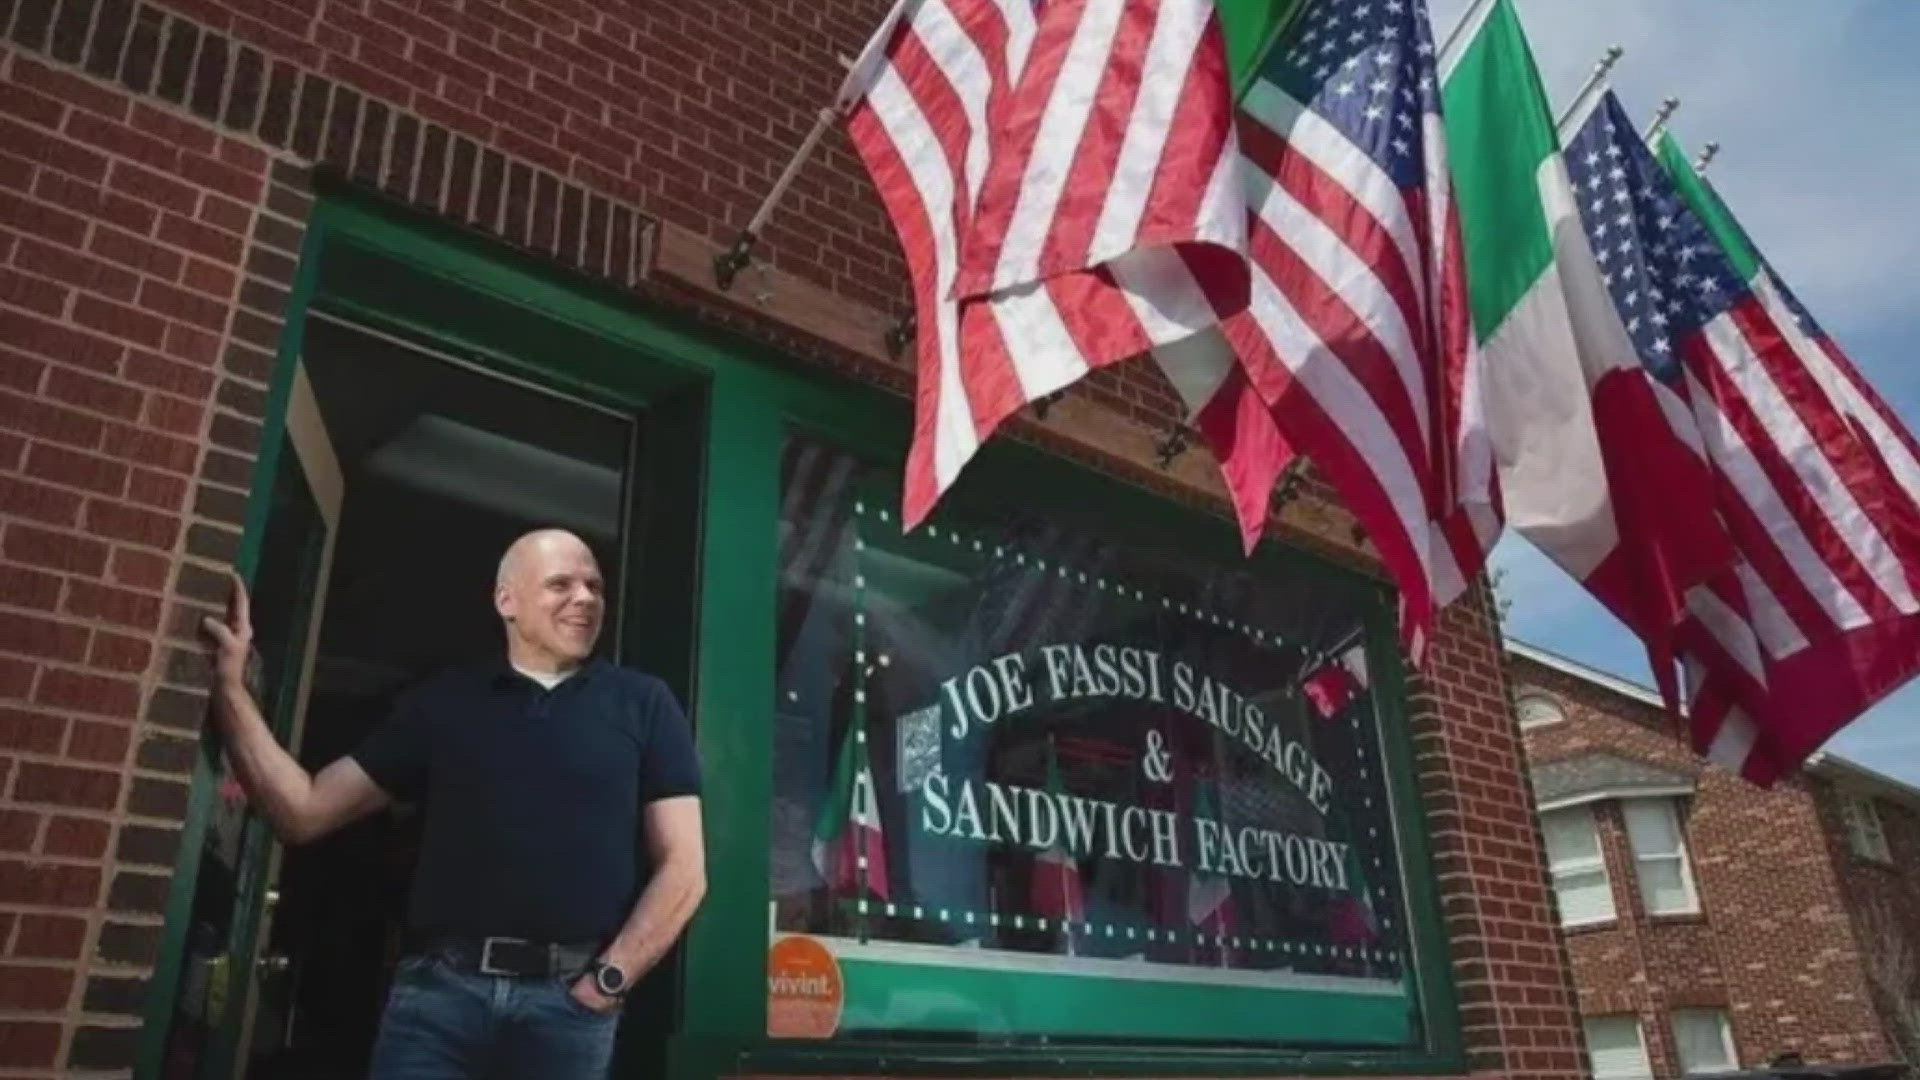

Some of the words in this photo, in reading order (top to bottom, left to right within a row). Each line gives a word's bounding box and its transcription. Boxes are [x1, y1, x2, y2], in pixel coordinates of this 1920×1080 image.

[942, 653, 1033, 739] JOE
[1041, 644, 1164, 702] FASSI
[1173, 661, 1333, 813] SAUSAGE
[1143, 729, 1173, 782] &
[923, 771, 1181, 866] SANDWICH
[1195, 817, 1350, 890] FACTORY
